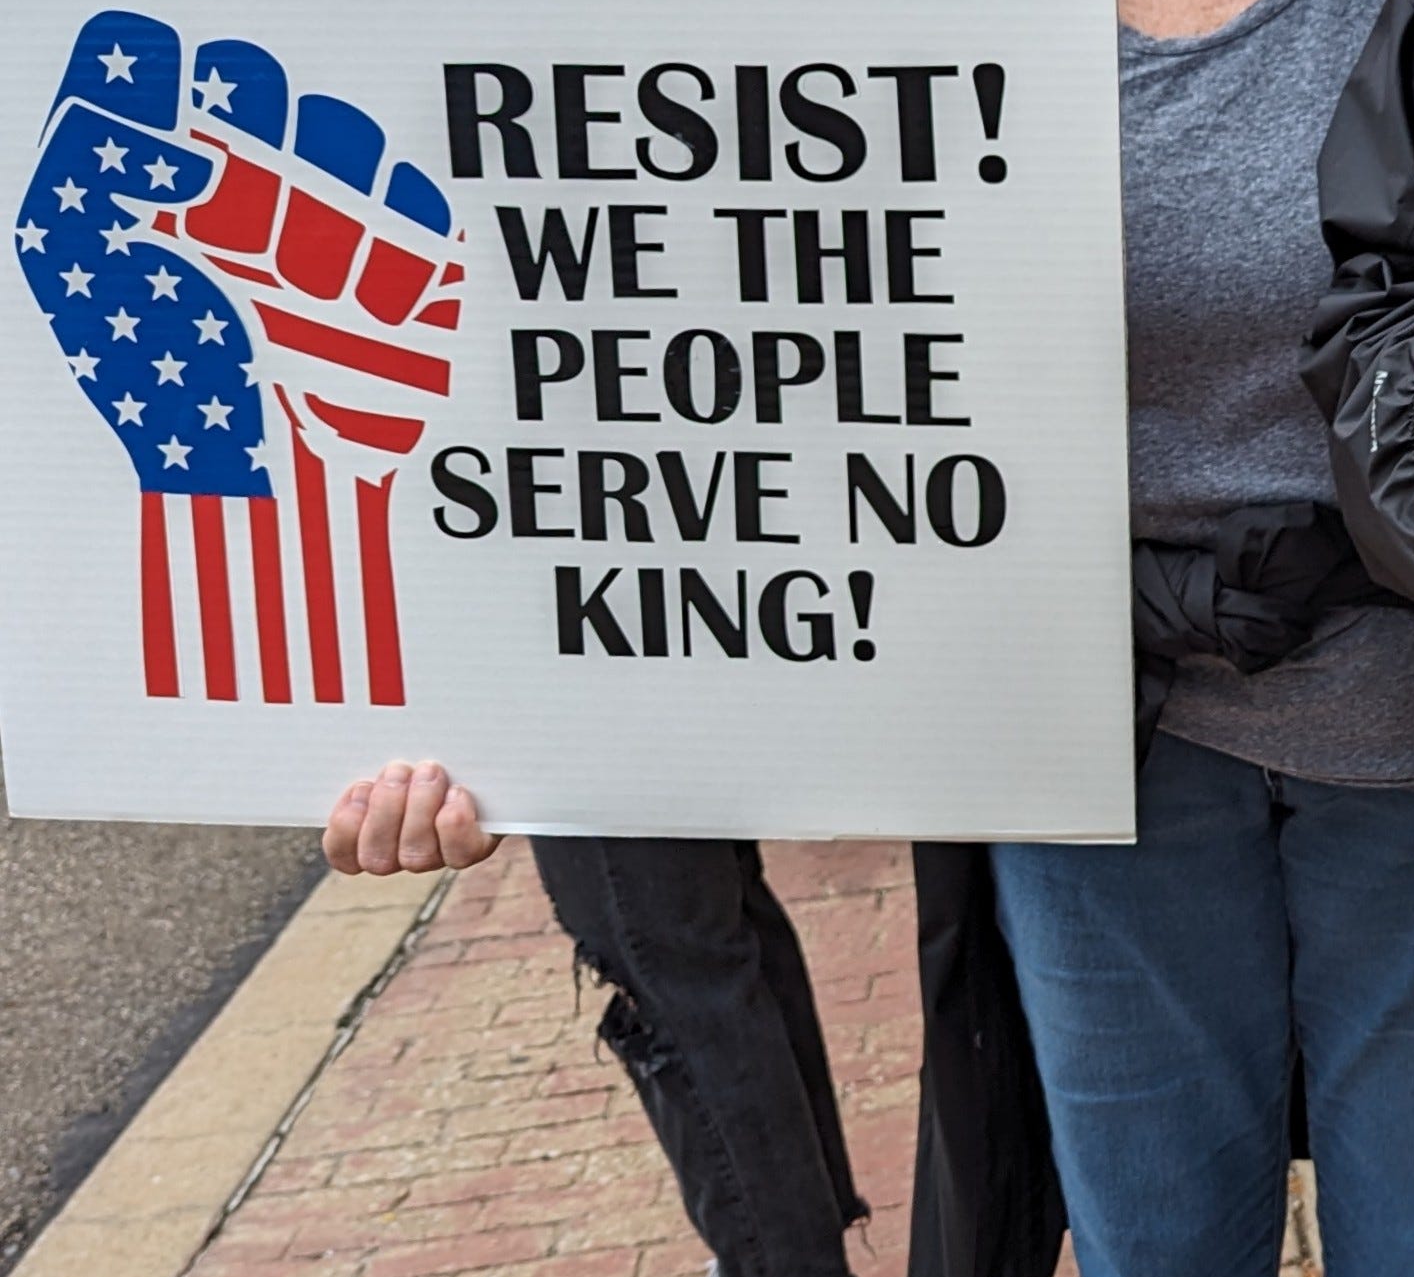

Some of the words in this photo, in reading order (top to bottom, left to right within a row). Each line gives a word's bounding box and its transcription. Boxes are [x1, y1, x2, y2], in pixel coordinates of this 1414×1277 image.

[443, 62, 1009, 184] RESIST!
[494, 205, 679, 302] WE
[713, 208, 955, 305] THE
[510, 328, 972, 427] PEOPLE
[430, 445, 801, 545] SERVE
[846, 452, 1007, 548] NO
[554, 565, 876, 663] KING!
